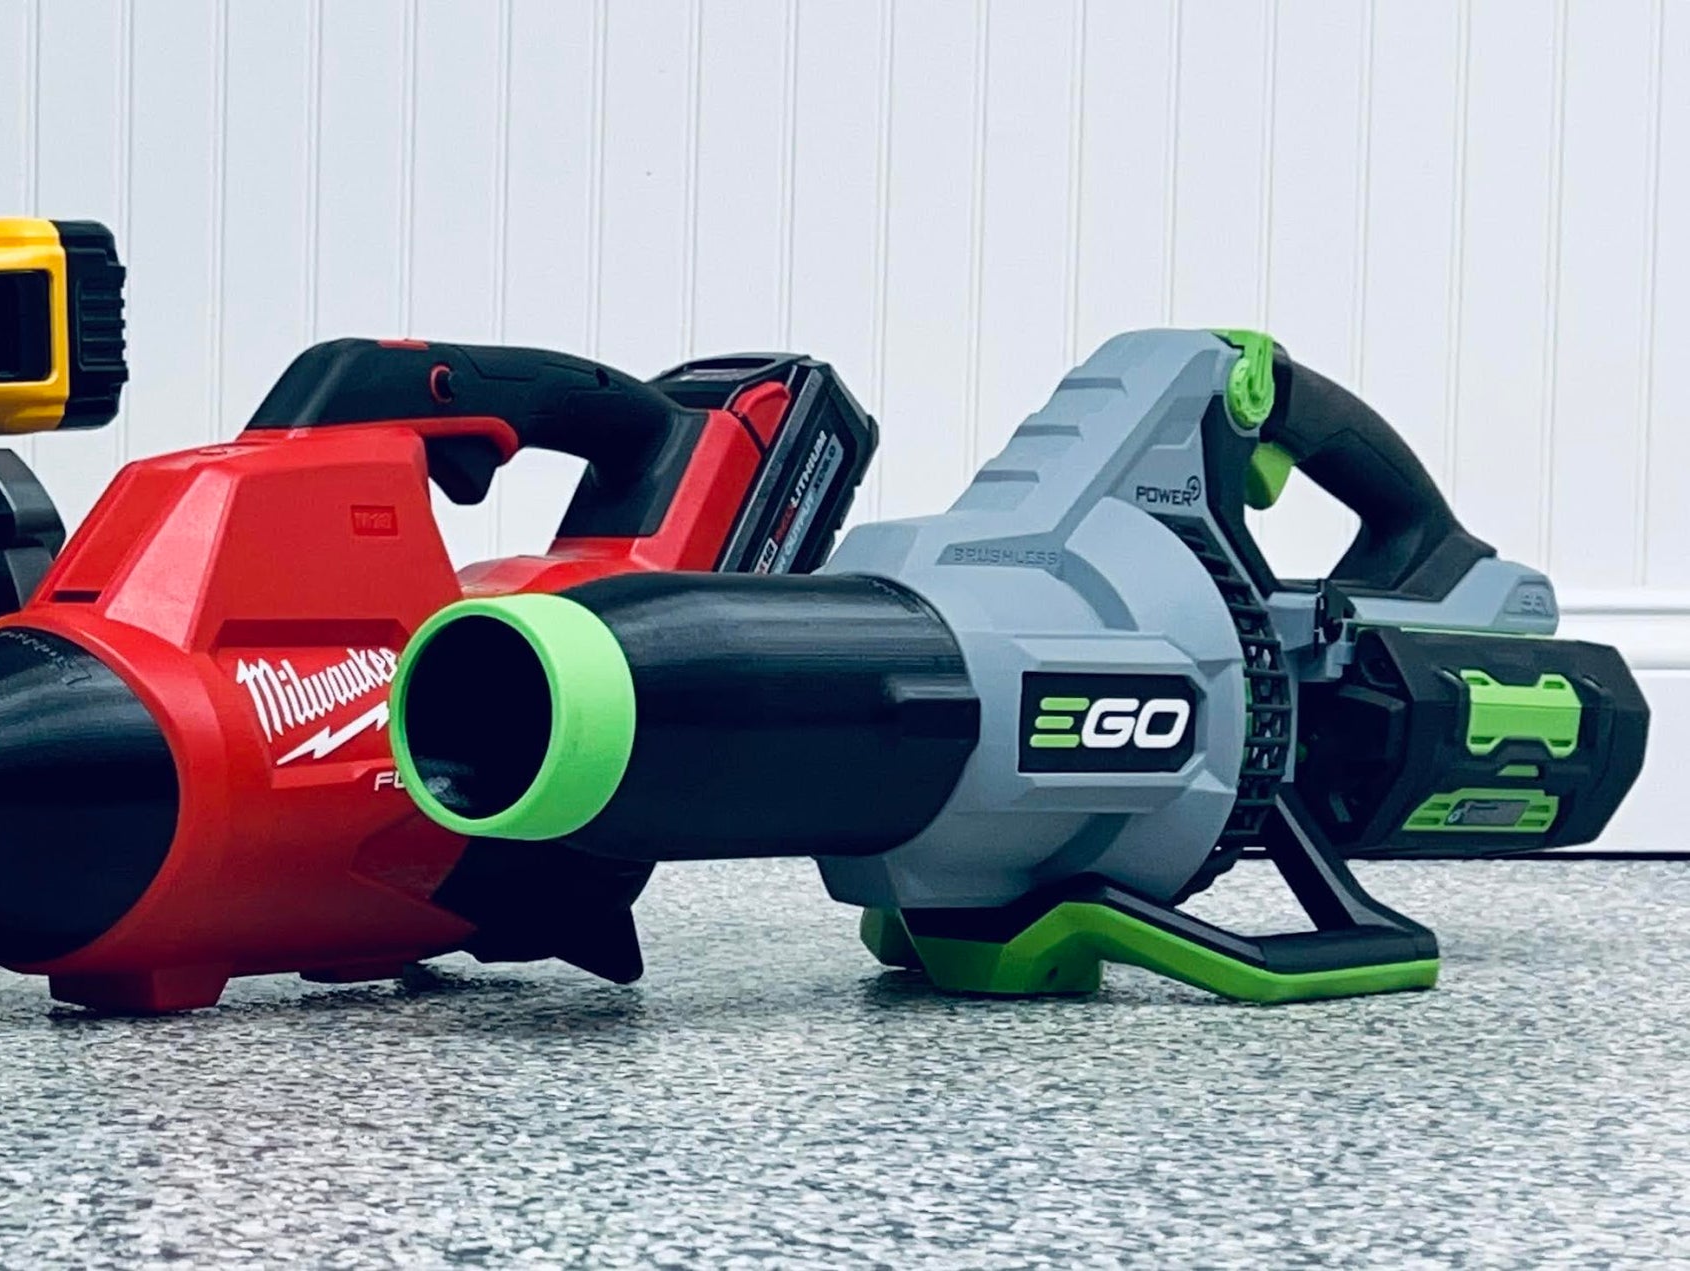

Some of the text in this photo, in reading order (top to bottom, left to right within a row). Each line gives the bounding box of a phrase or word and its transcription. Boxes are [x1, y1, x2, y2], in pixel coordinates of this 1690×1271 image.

[953, 546, 1058, 566] BRUSHLESS
[236, 647, 398, 743] Milwaukee
[1029, 697, 1190, 748] EGO
